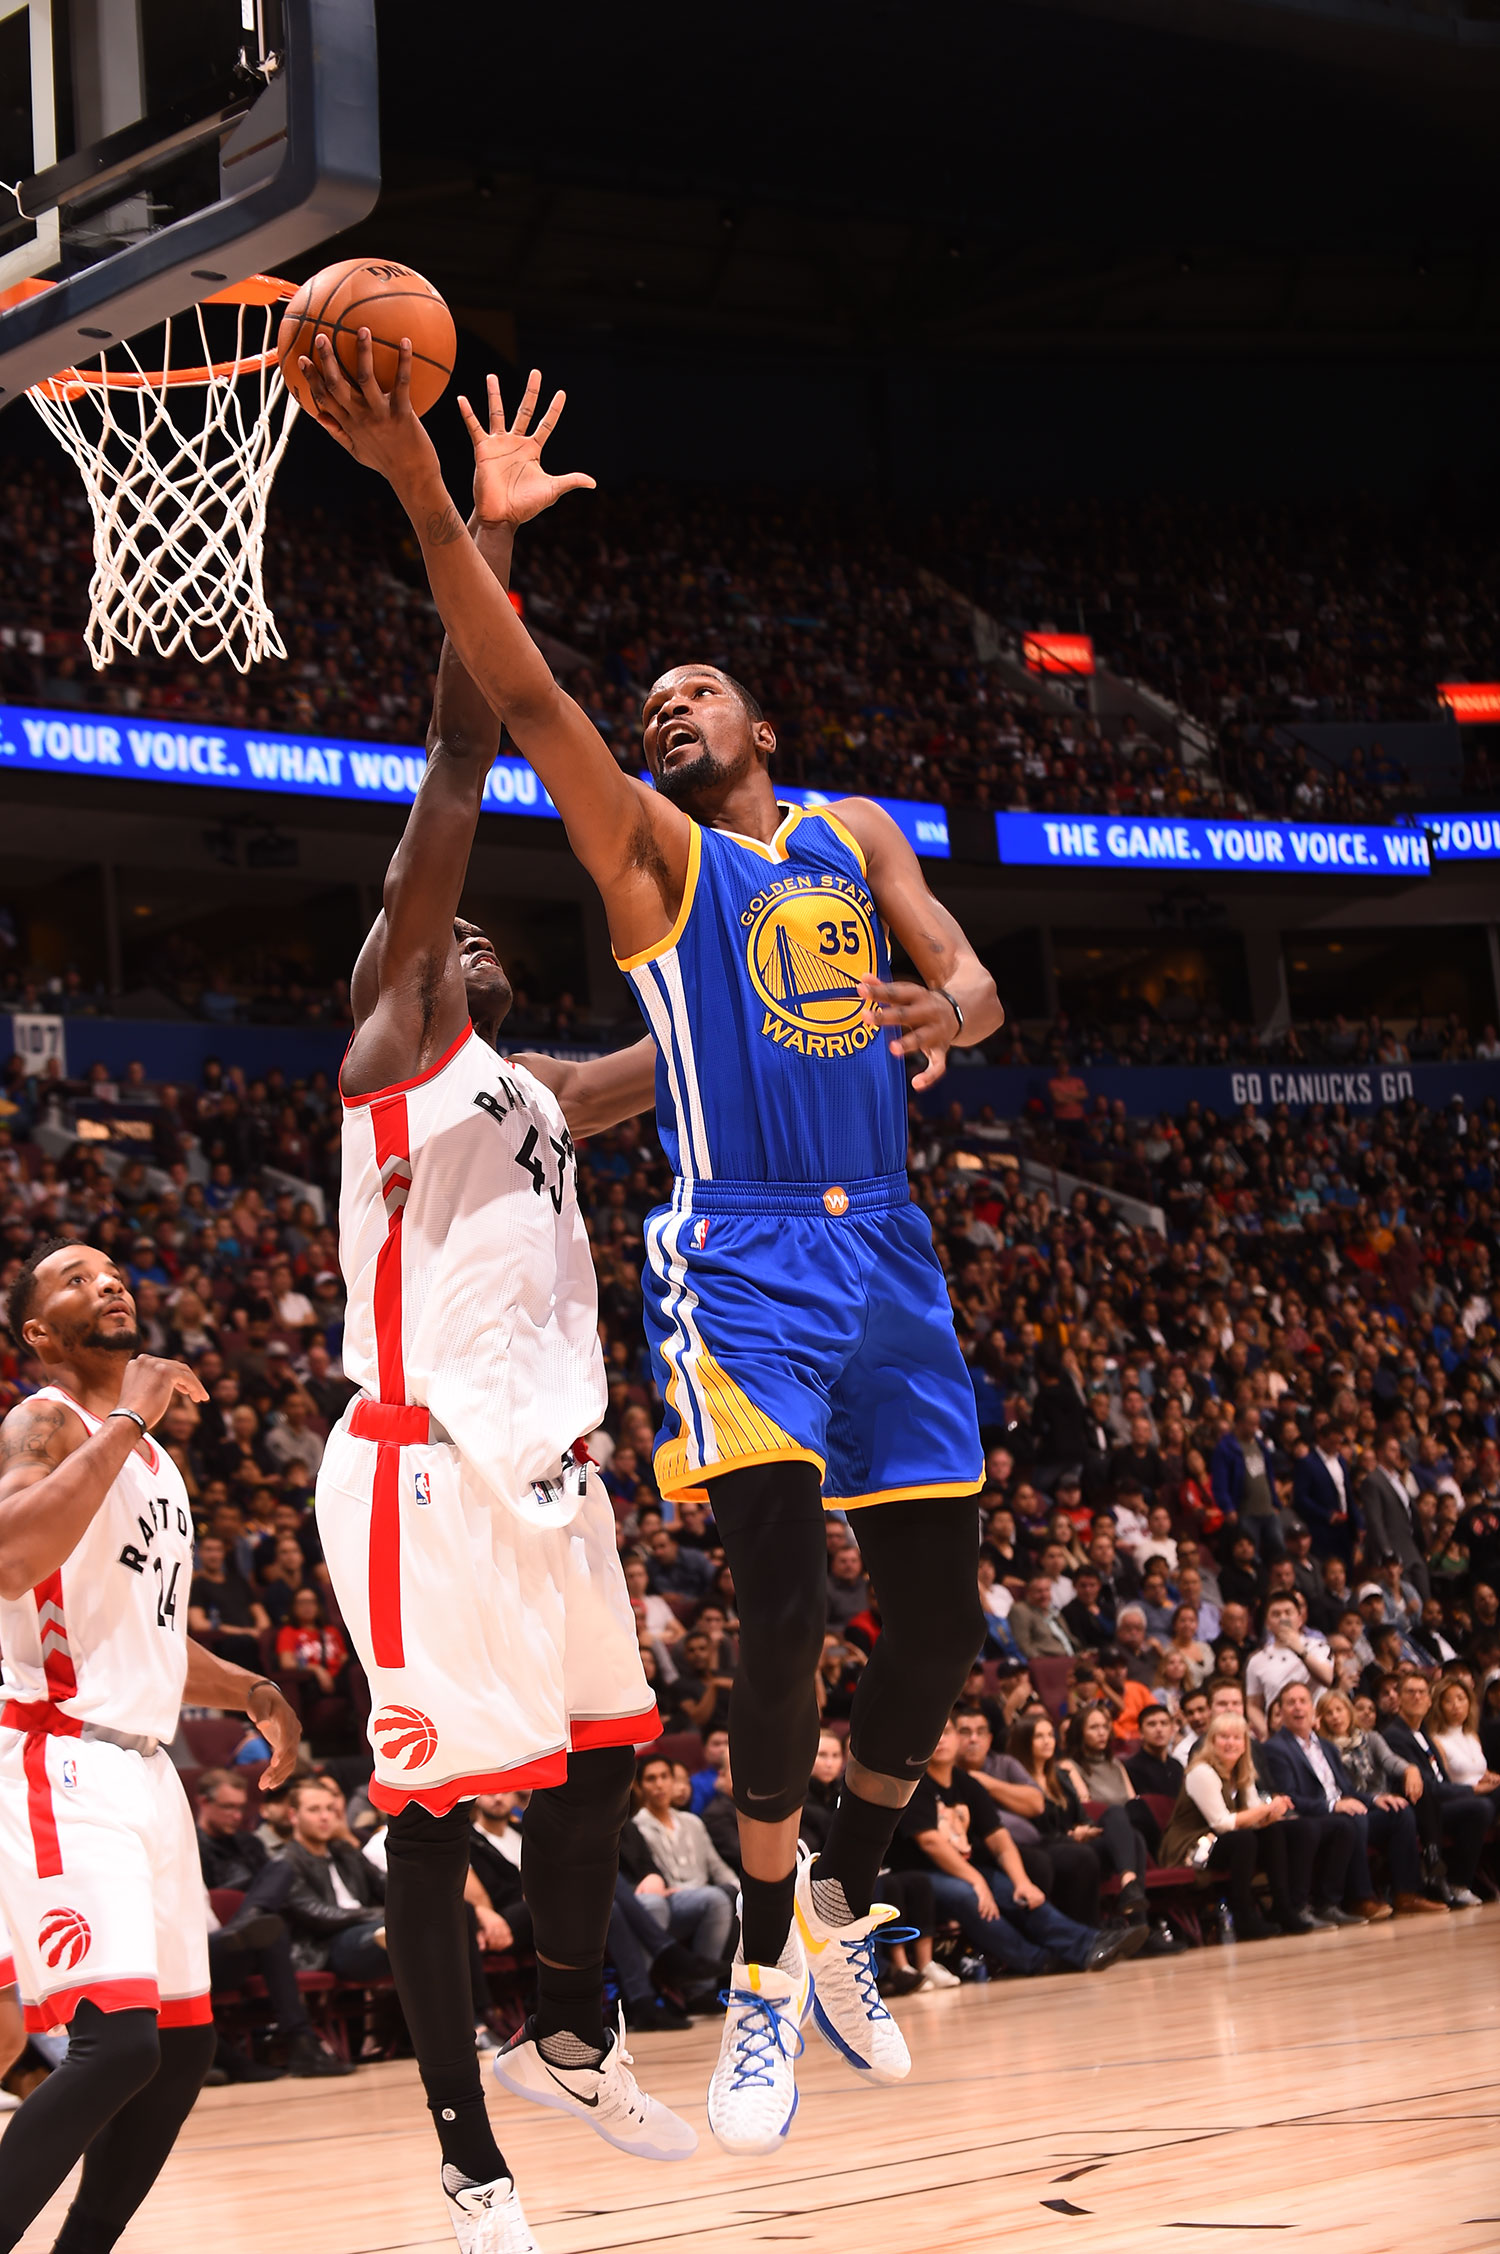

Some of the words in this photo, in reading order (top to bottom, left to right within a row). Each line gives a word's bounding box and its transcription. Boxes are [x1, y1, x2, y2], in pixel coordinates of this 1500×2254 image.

[21, 718, 123, 766] YOUR
[127, 729, 240, 777] VOICE.
[245, 740, 343, 786] WHAT
[349, 751, 428, 794] WOU
[1043, 822, 1100, 856] THE
[1106, 824, 1201, 860] GAME.
[1206, 828, 1285, 863] YOUR
[1289, 831, 1378, 866] VOICE.
[740, 875, 812, 927] GOLDEN
[820, 875, 875, 917] STATE
[816, 921, 860, 955] 35
[1231, 1073, 1263, 1105] GO
[1269, 1073, 1373, 1105] CANUCKS
[1380, 1071, 1413, 1104] GO
